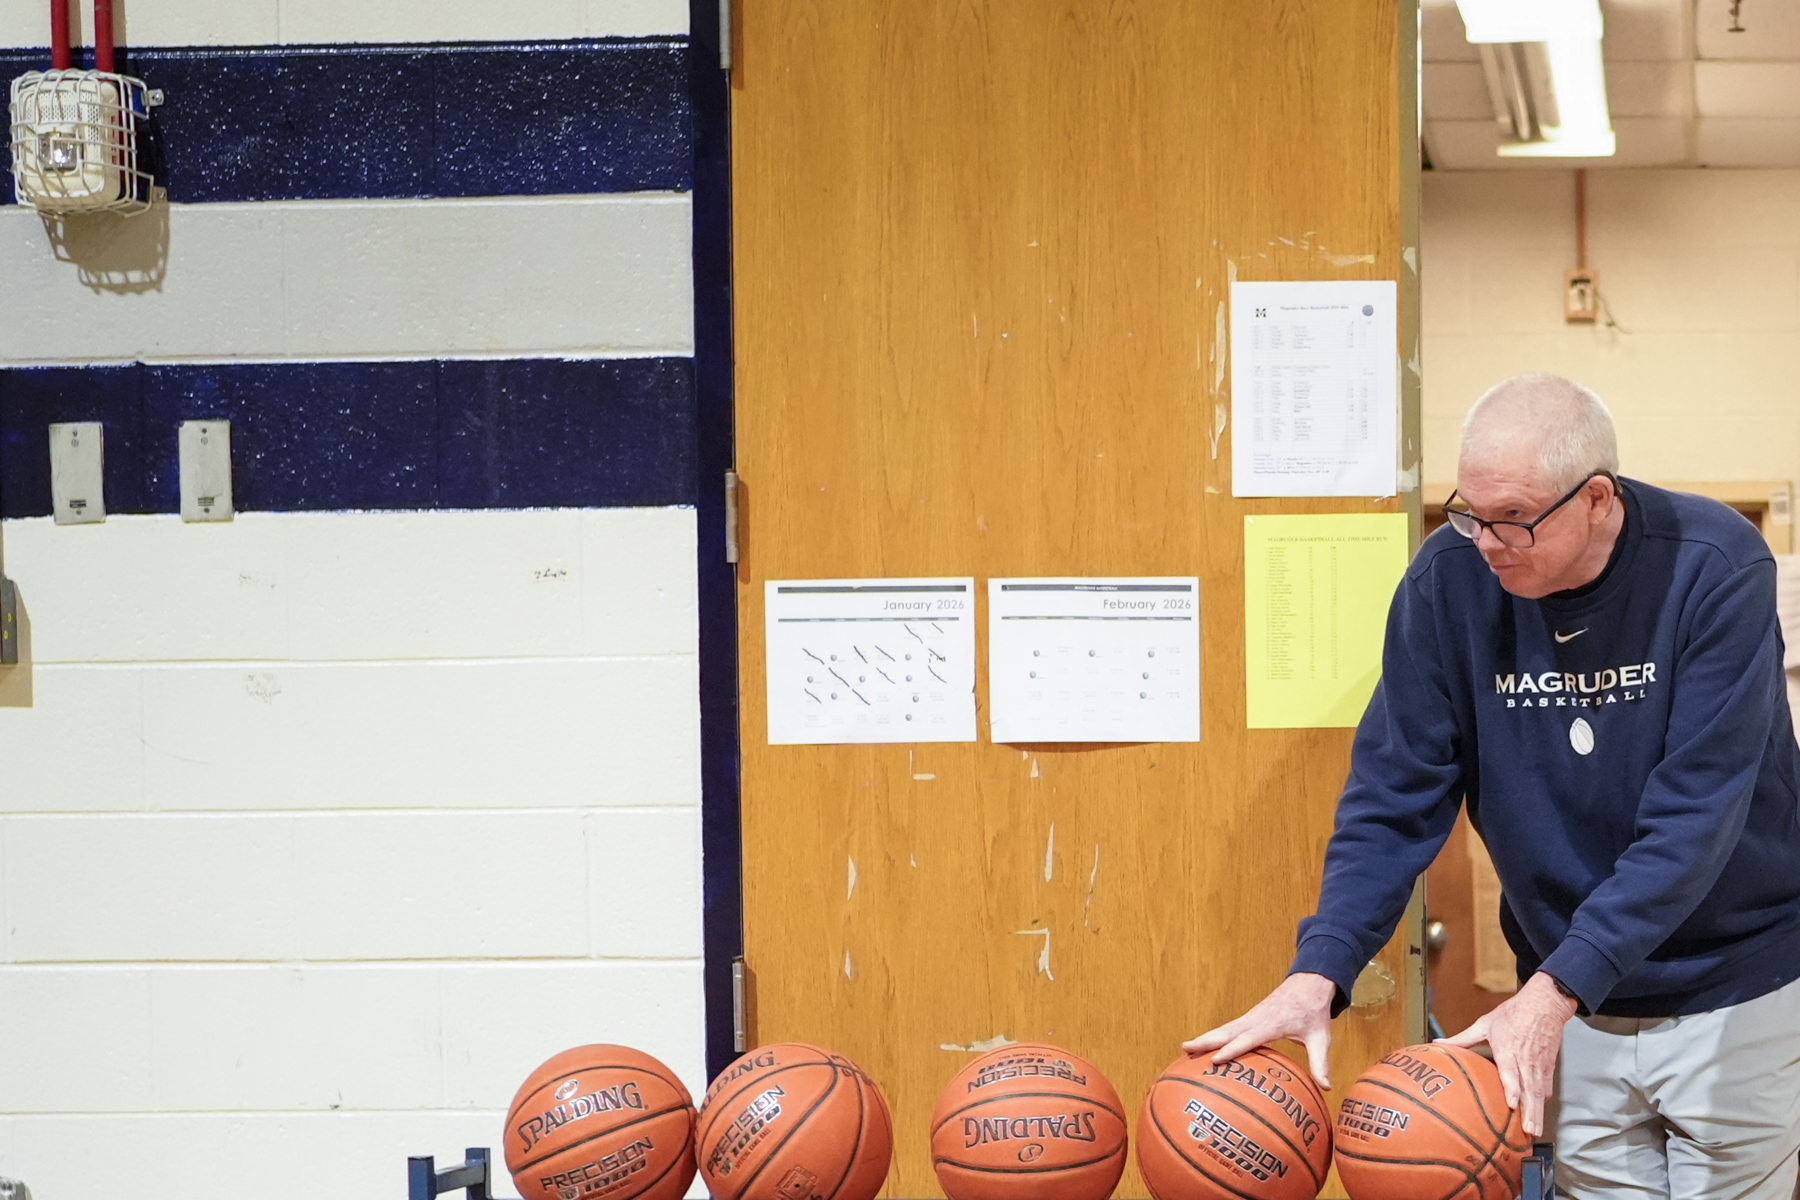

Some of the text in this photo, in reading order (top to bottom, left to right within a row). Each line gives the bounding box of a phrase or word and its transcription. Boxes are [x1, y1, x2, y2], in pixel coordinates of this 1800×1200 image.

[883, 599, 965, 612] January 2026
[1103, 598, 1191, 612] February 2026
[1495, 662, 1656, 695] MAGRUDER
[1506, 689, 1646, 708] BASKETBALL
[967, 1064, 1087, 1093] PRECISION
[517, 1081, 644, 1154] SPALDING
[1202, 1060, 1321, 1147] SPALDING
[706, 1084, 786, 1178] PRECISION
[730, 1103, 782, 1159] 1000
[760, 1128, 772, 1142] BALL
[964, 1111, 1096, 1148] SPALDING
[1183, 1098, 1289, 1179] PRECISION
[540, 1136, 655, 1192] PRECISION
[584, 1158, 647, 1192] 1000
[1197, 1143, 1244, 1179] OFFICIAL GAME BALL
[1208, 1136, 1271, 1182] 1000
